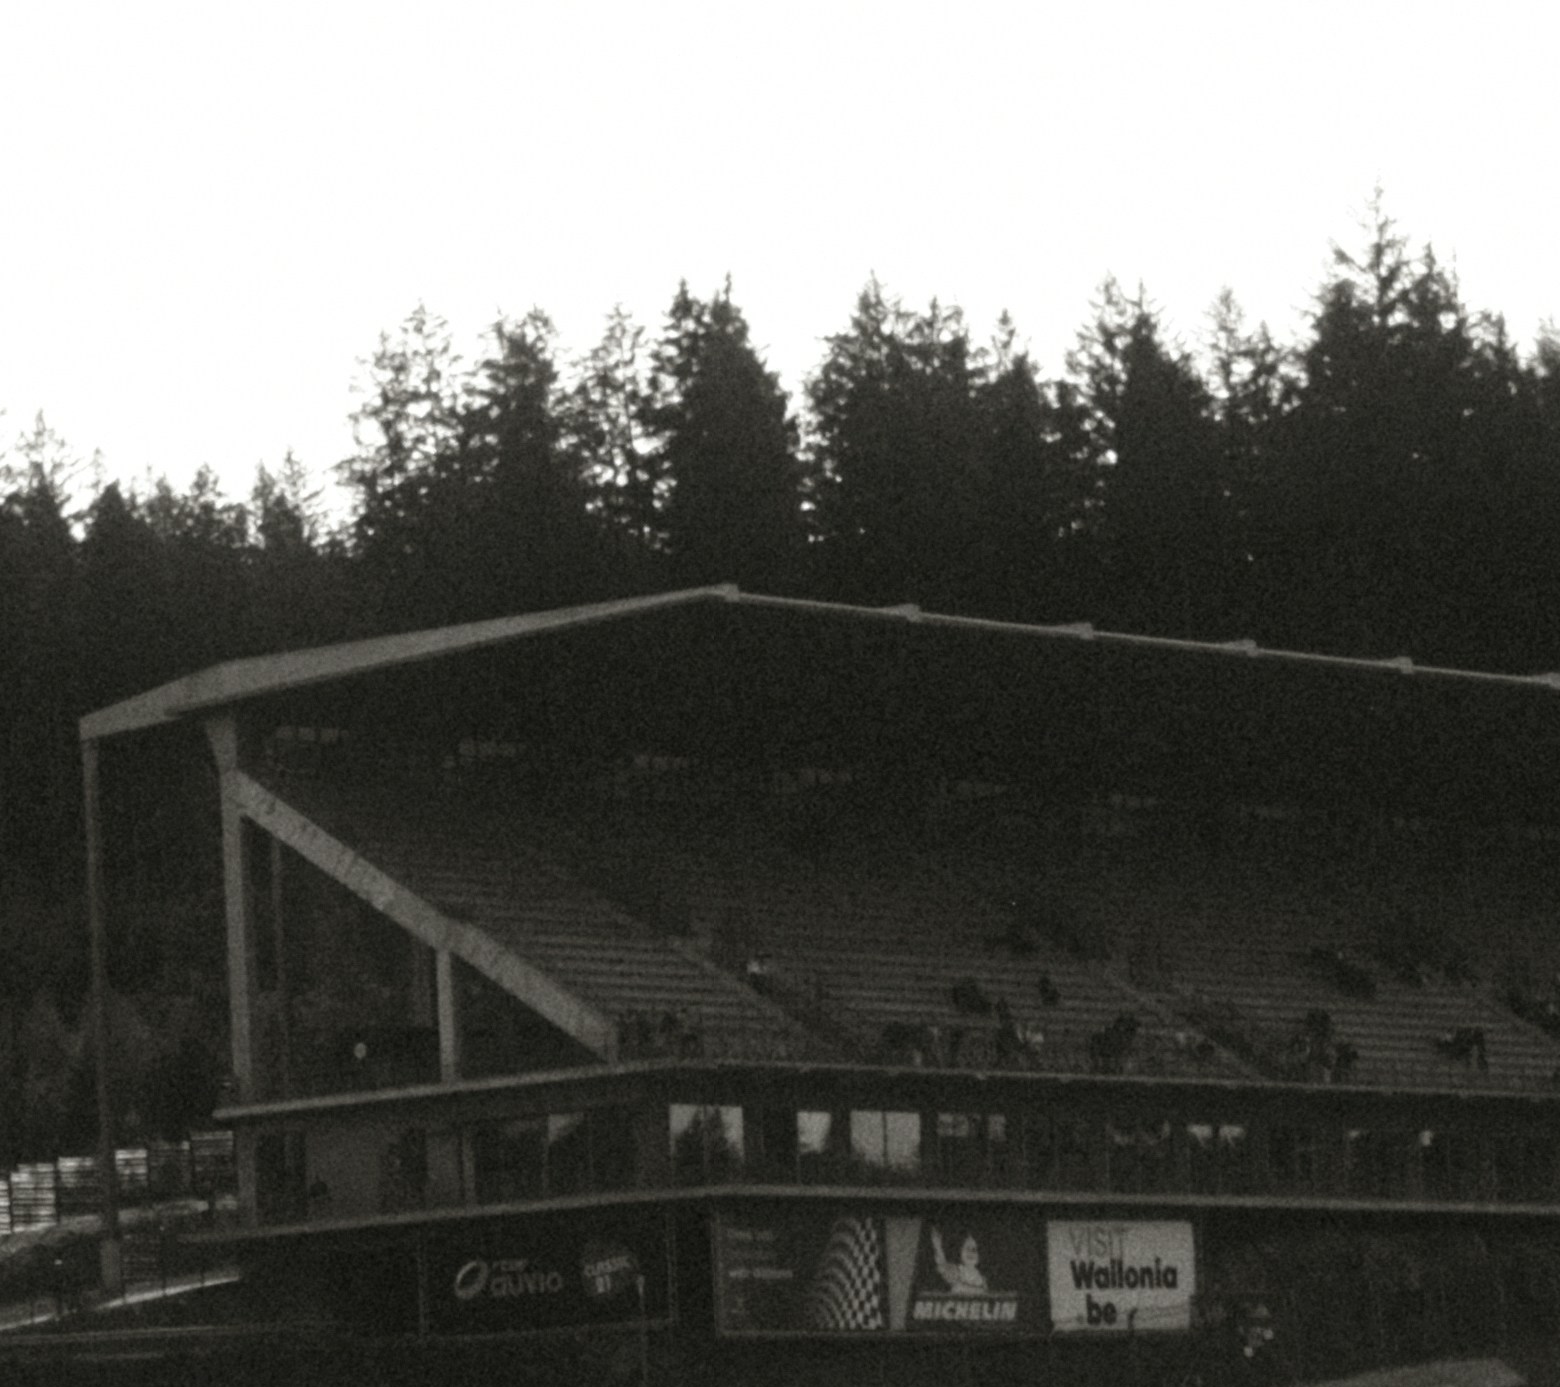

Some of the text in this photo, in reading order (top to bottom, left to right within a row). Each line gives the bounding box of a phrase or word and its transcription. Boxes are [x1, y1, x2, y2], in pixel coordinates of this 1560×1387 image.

[1068, 1225, 1126, 1258] VISIT
[1070, 1256, 1178, 1289] Wallonia
[912, 1299, 1019, 1321] MICHELIN
